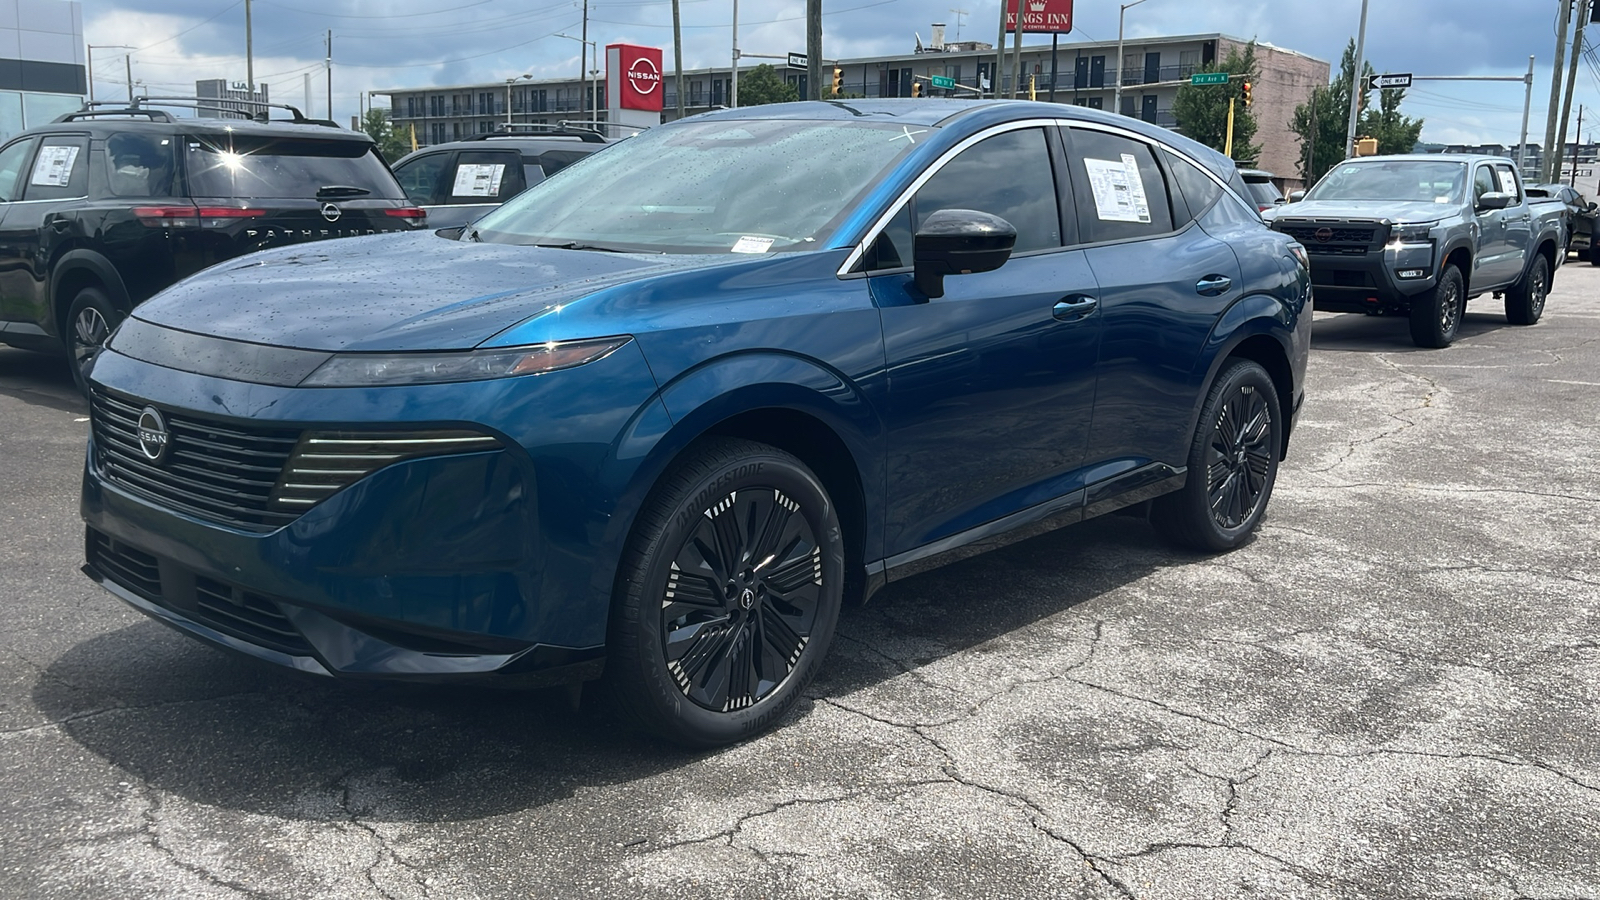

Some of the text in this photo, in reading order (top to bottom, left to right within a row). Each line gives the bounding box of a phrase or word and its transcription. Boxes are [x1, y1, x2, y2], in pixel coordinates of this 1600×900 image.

[1007, 12, 1069, 24] KINGS INN
[628, 71, 660, 81] NISSAN
[676, 462, 765, 532] BRIDGESTONE
